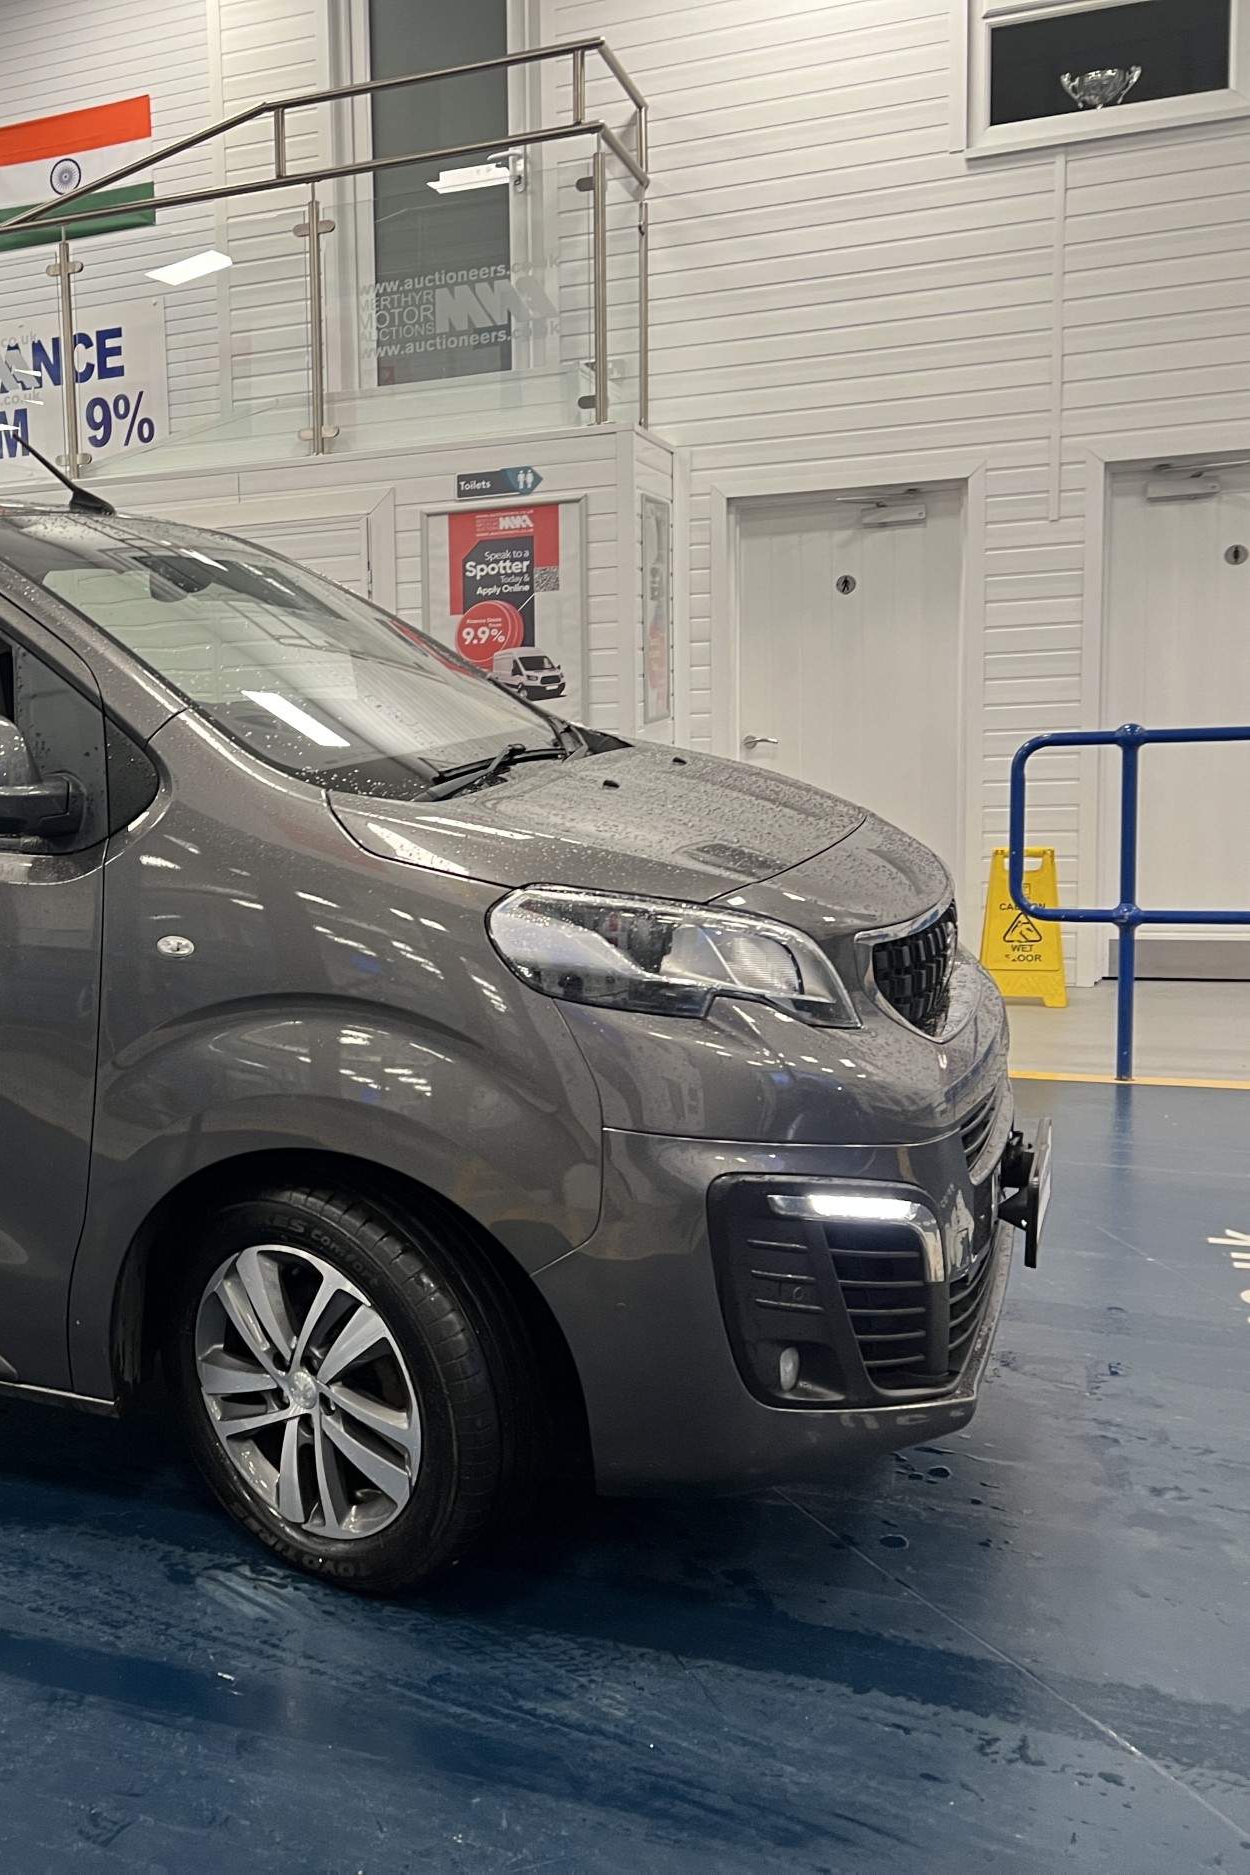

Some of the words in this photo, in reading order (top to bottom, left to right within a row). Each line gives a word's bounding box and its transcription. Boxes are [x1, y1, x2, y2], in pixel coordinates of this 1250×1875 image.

[359, 256, 561, 295] www.auctioneers.cok
[359, 289, 434, 313] MERTHYR
[360, 304, 435, 330] MOTOR
[360, 323, 436, 343] AUCTIONS
[361, 323, 561, 360] www.auctioneers.cok
[85, 390, 155, 448] 9%
[459, 480, 491, 491] Toilets
[484, 549, 512, 562] Speak
[513, 550, 522, 558] to
[523, 550, 530, 558] a
[465, 560, 530, 580] Spotter
[500, 575, 523, 586] Today
[523, 574, 530, 582] &
[476, 585, 502, 596] Apply
[502, 584, 530, 593] Online
[462, 626, 505, 645] 9.9%
[999, 902, 1046, 911] CAON
[1011, 944, 1035, 952] WET
